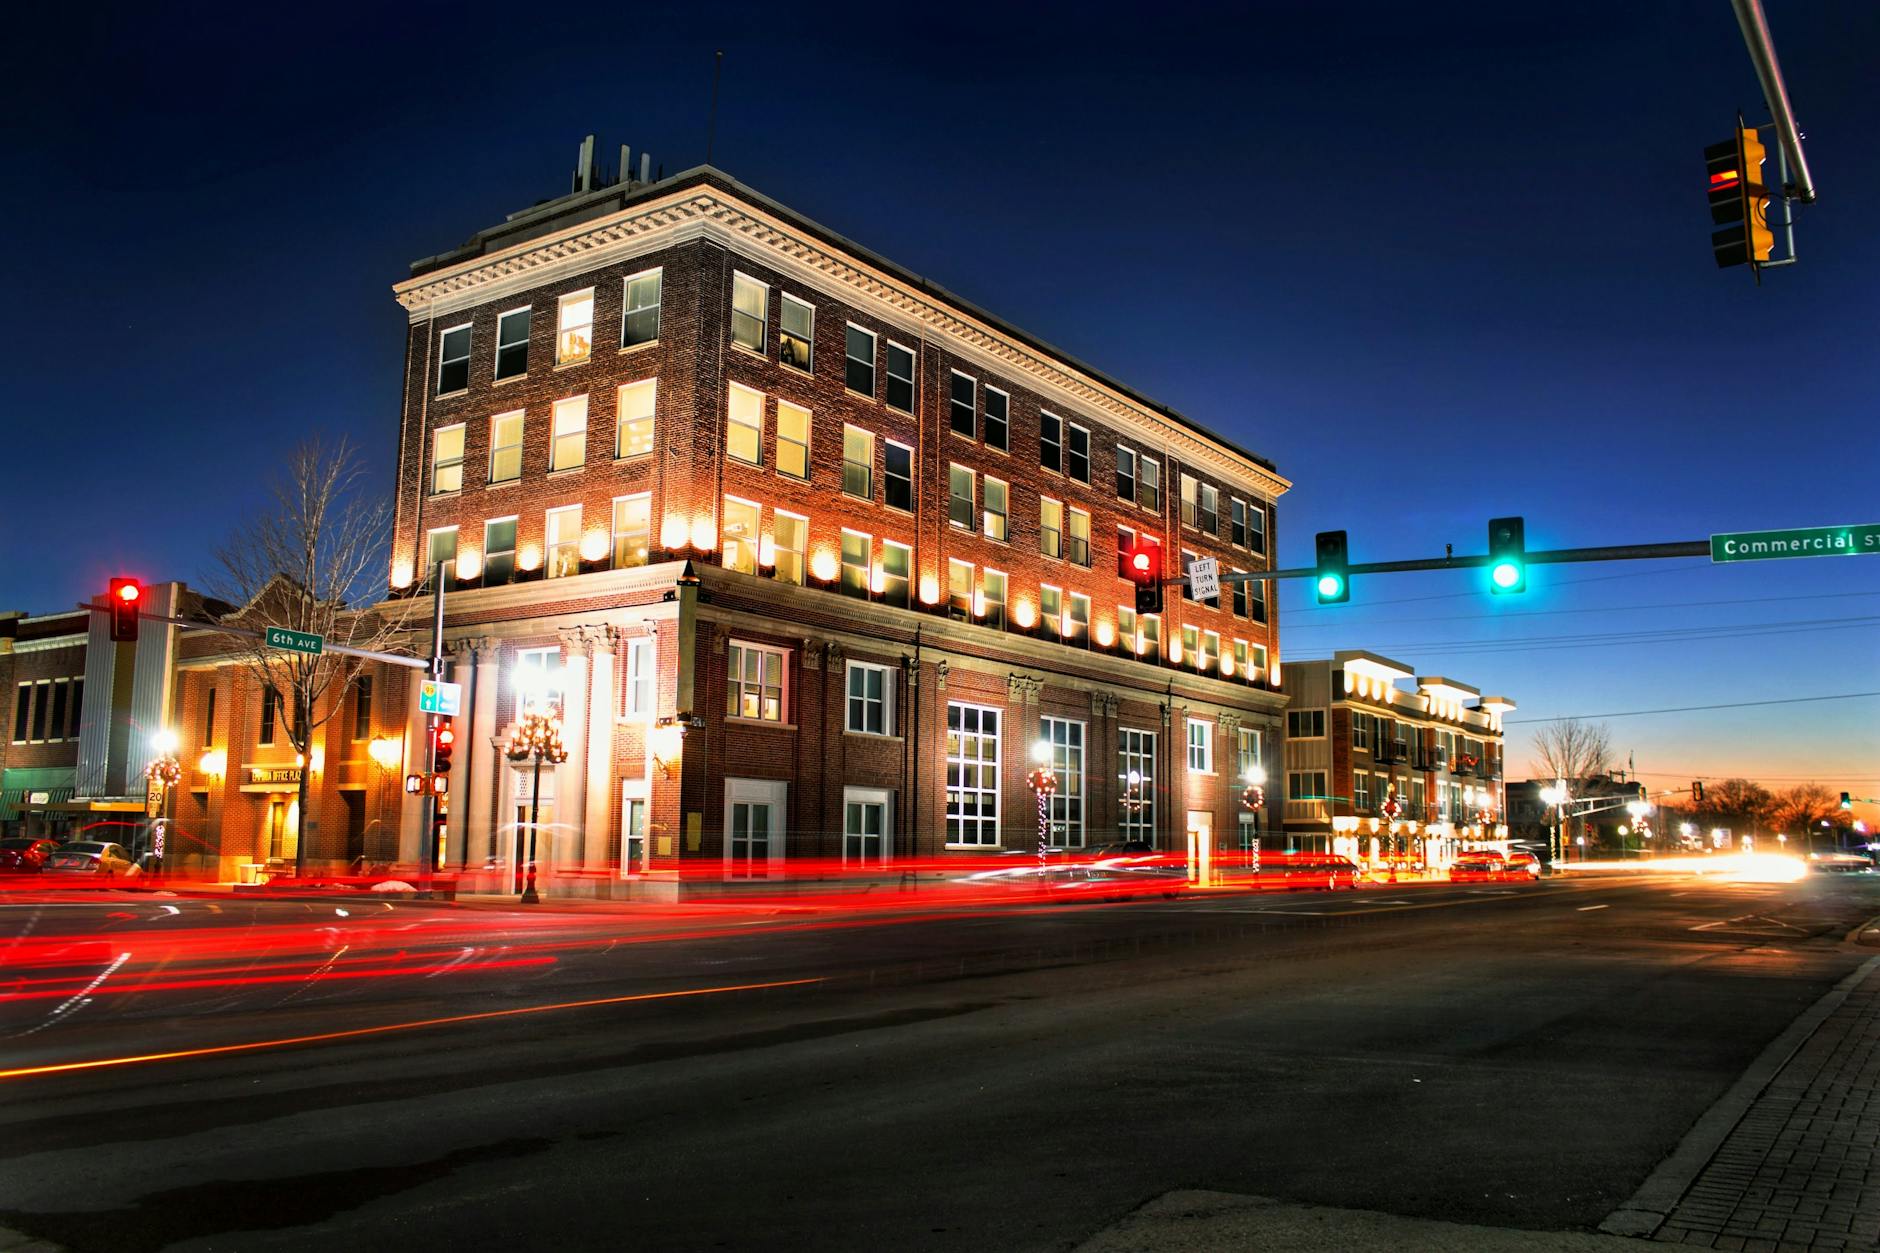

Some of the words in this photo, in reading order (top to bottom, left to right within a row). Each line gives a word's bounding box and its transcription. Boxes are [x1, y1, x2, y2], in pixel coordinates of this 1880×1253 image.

[1724, 533, 1854, 555] Commercial
[1195, 562, 1211, 573] LEFT
[1195, 573, 1213, 584] TURN
[1194, 585, 1218, 596] SIGNAL
[272, 632, 293, 646] 6th
[297, 639, 317, 649] AVE
[289, 770, 302, 781] PLAZ
[149, 792, 162, 802] 20
